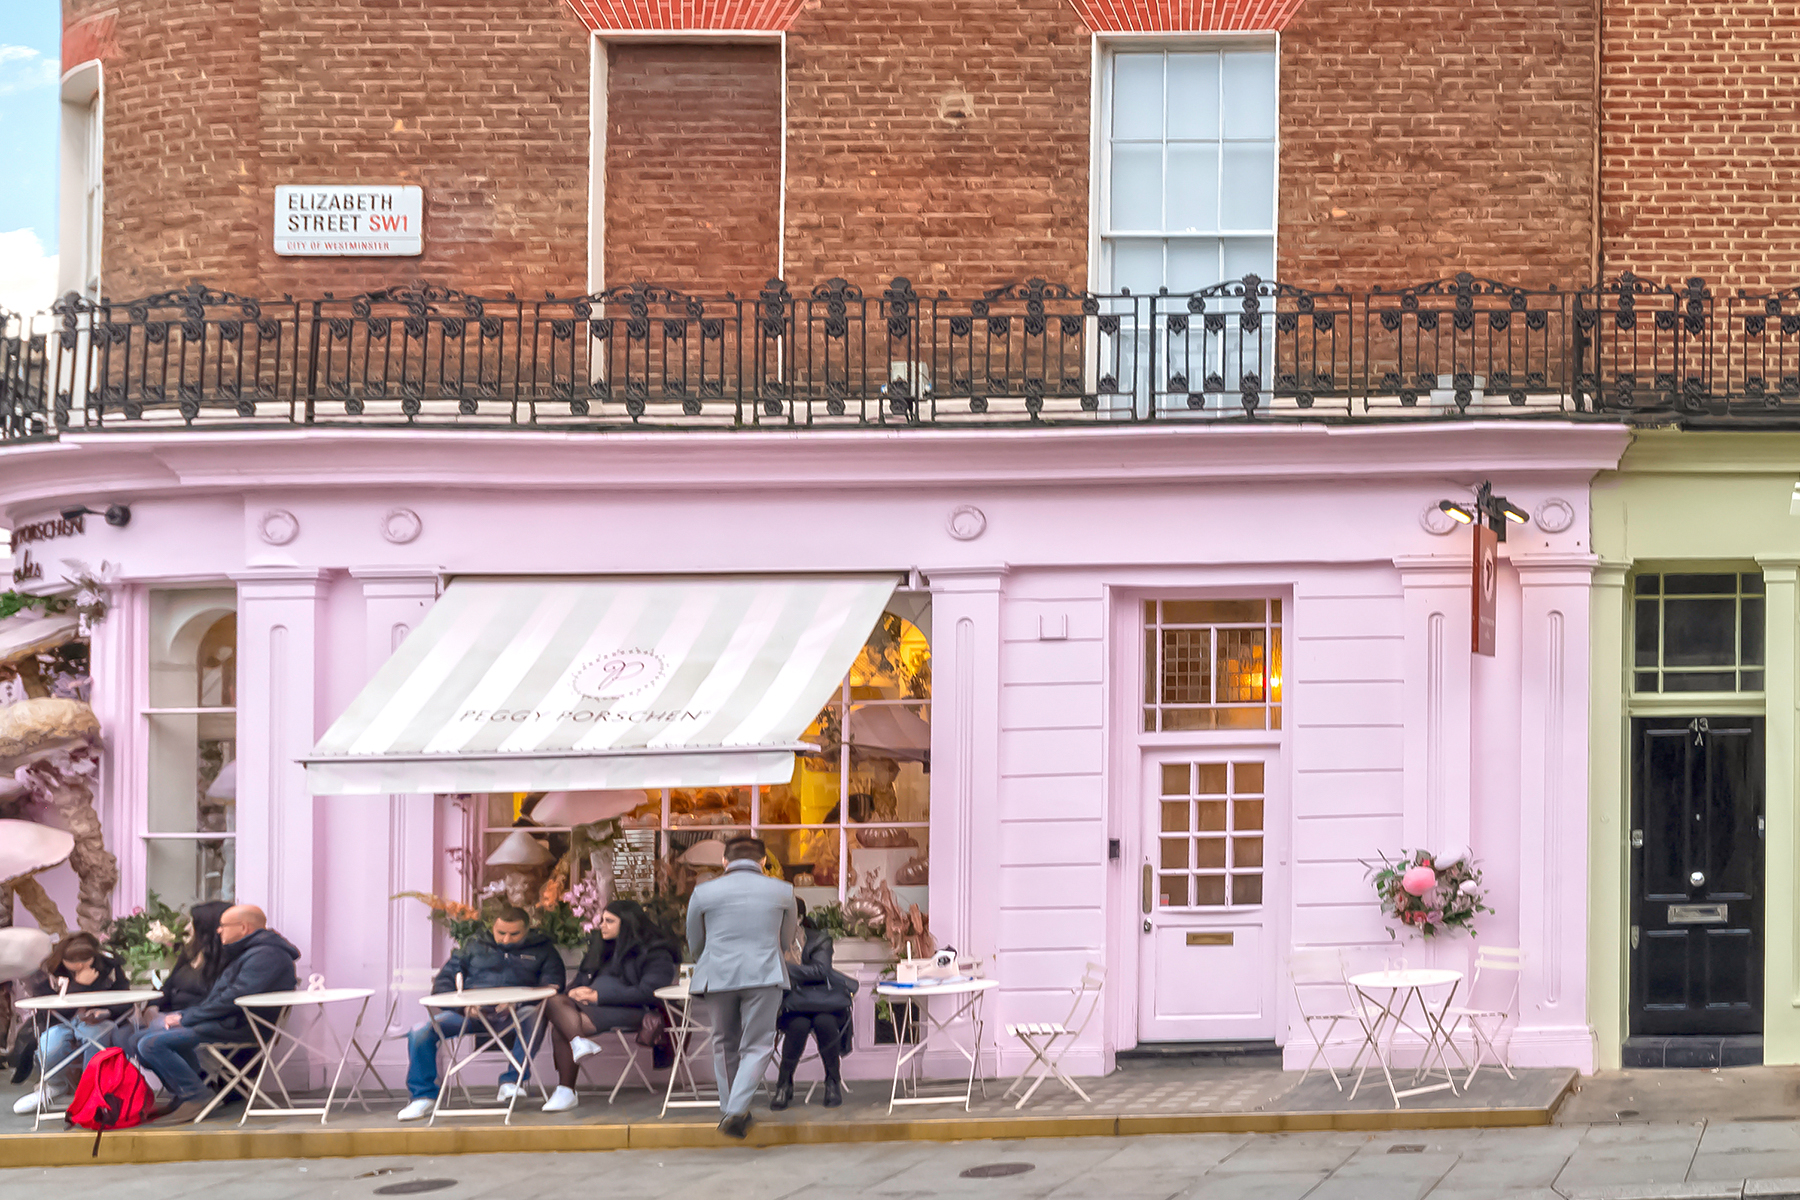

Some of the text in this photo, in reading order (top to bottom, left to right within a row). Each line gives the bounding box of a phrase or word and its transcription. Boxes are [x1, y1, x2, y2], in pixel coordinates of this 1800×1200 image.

[288, 193, 392, 210] ELIZABETH
[288, 214, 408, 232] STREET SW1
[287, 241, 390, 250] CITY OF WESTMINSTER
[460, 709, 549, 723] PEGGY
